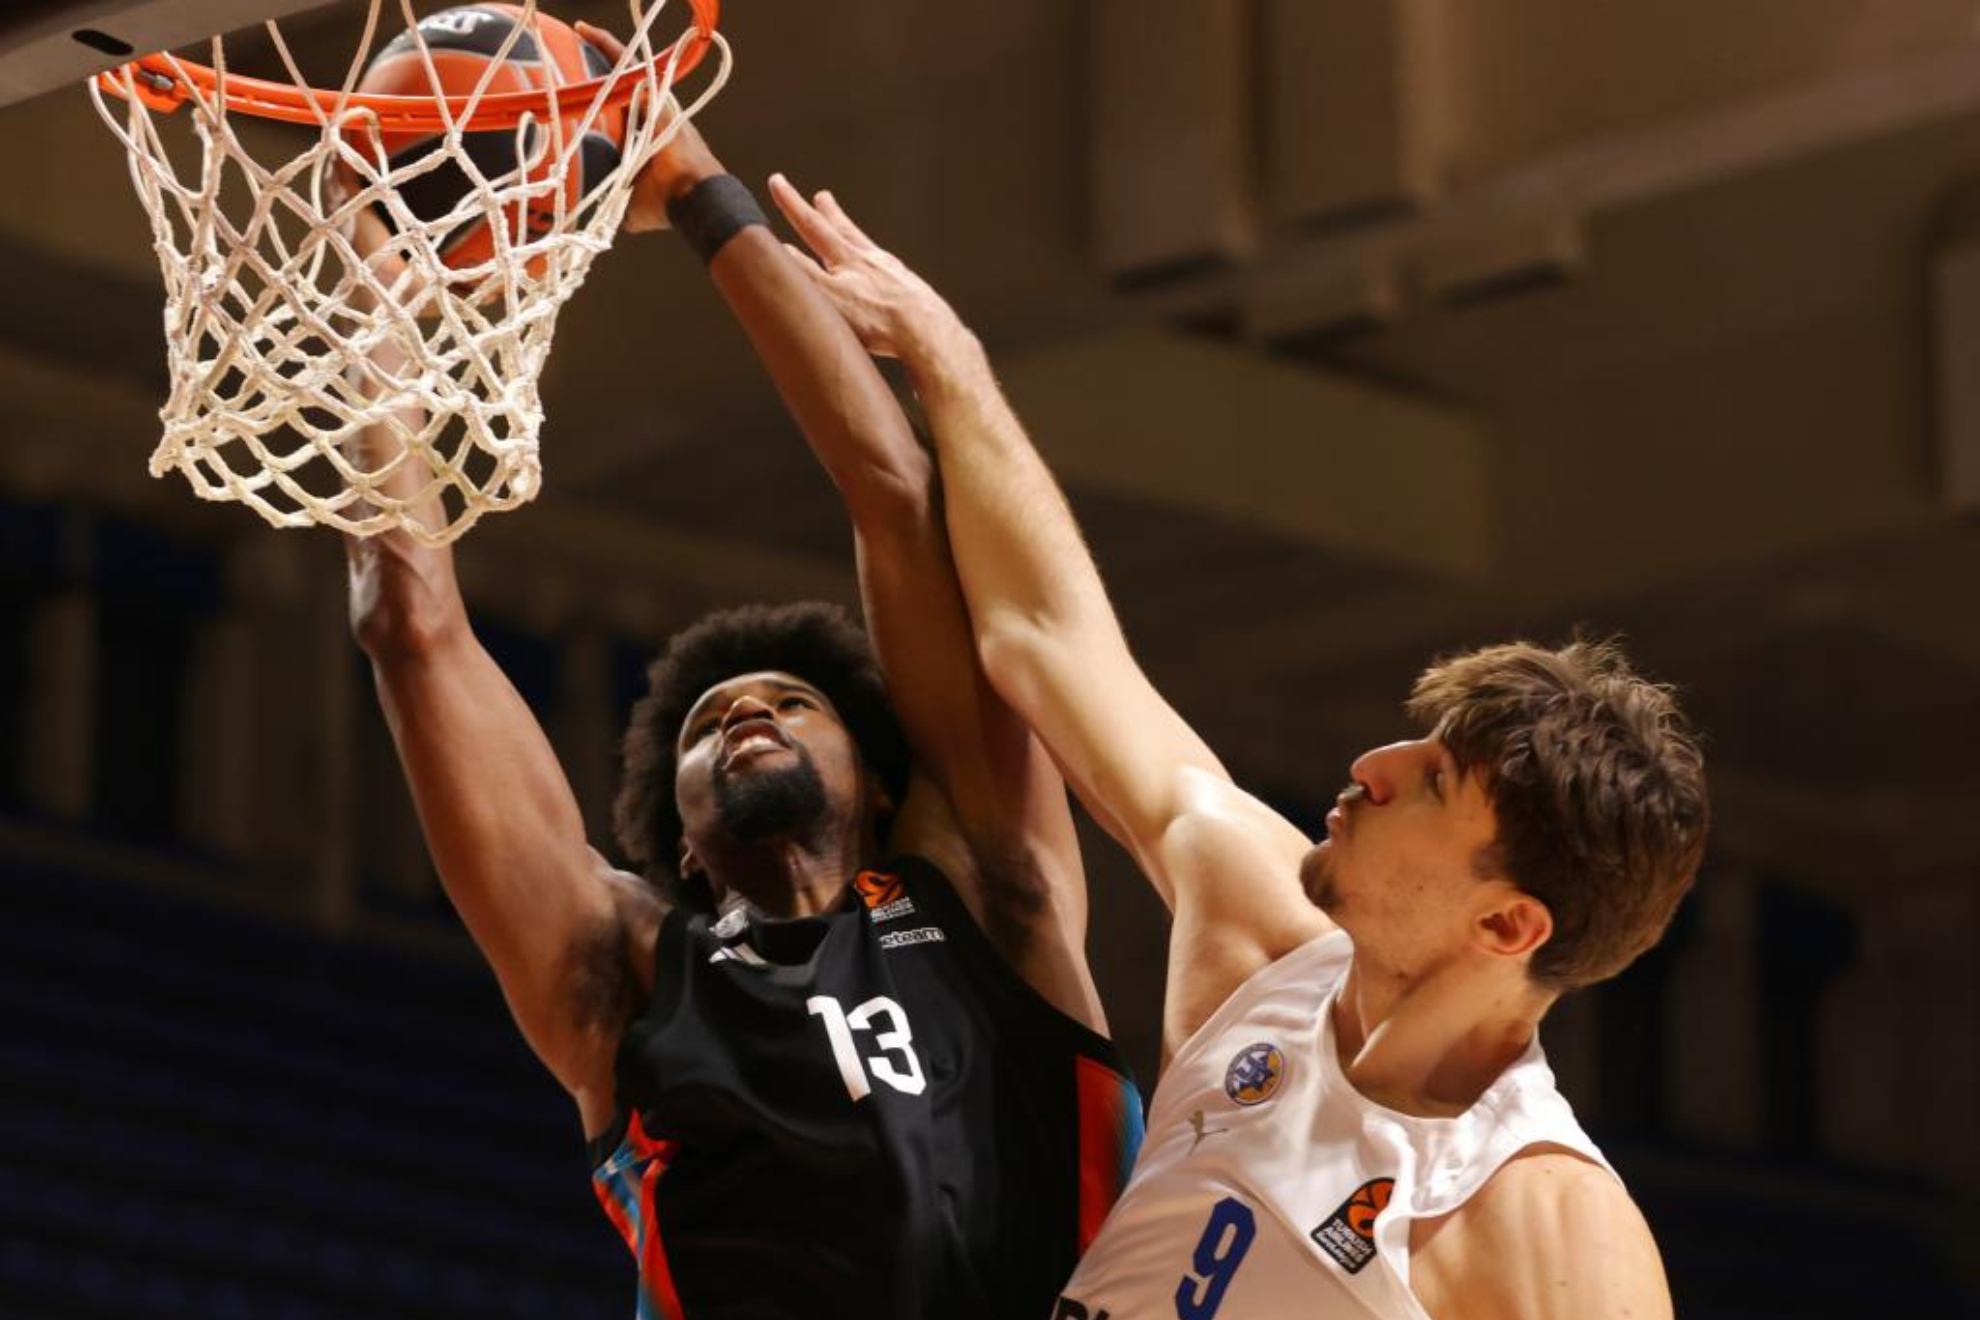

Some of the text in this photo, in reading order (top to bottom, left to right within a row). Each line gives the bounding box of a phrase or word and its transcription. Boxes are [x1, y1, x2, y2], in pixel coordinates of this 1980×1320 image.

[879, 926, 945, 949] eteam
[806, 995, 926, 1102] 13
[1175, 1197, 1257, 1320] 9
